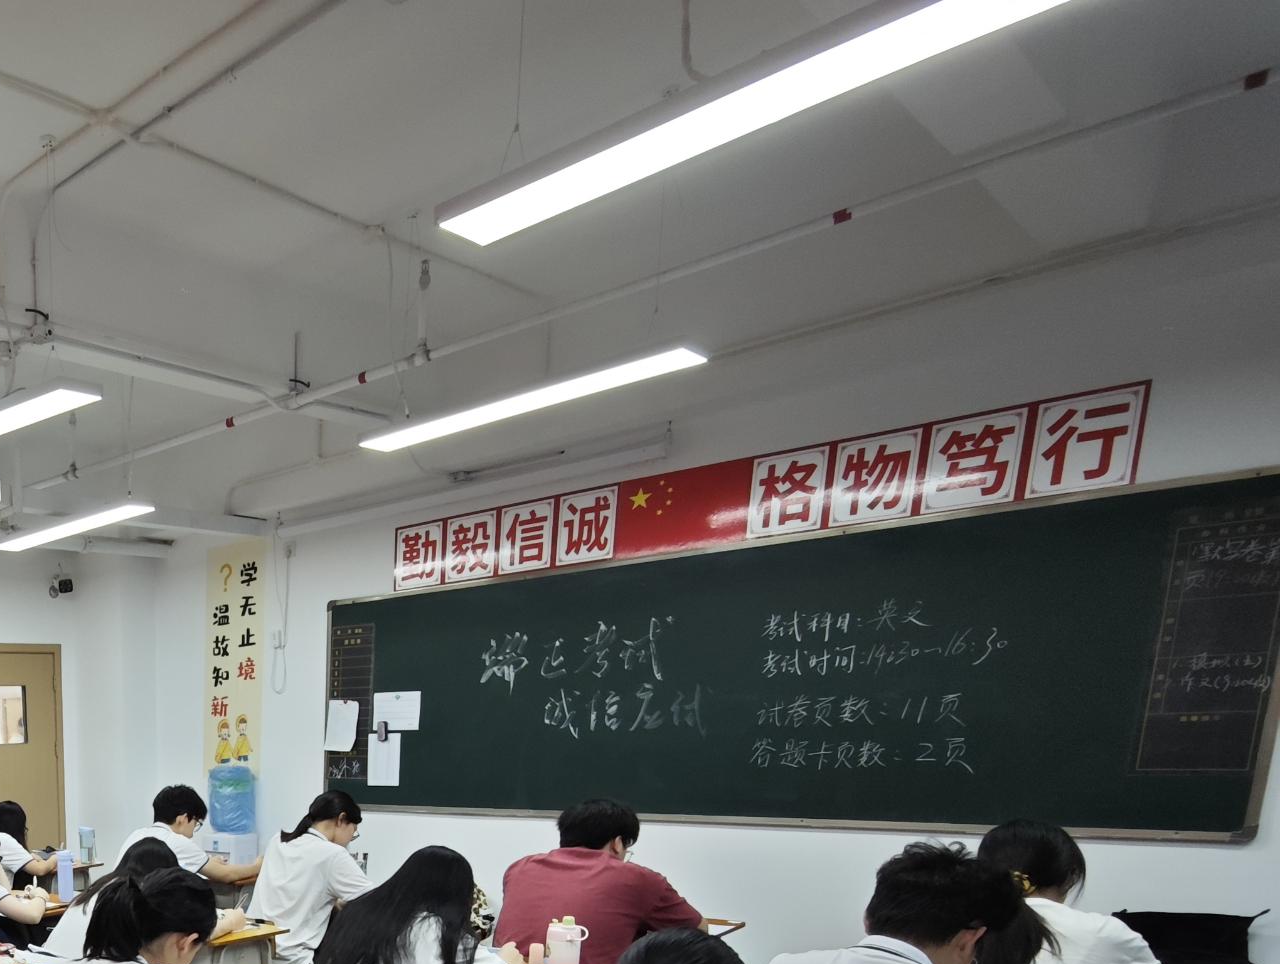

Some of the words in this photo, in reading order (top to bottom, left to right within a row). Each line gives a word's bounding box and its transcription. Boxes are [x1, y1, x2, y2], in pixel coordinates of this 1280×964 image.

[401, 496, 611, 582] 勤毅信诚
[759, 402, 1131, 529] 格物笃行
[211, 603, 231, 718] 温故知新
[237, 561, 258, 681] 学无止境
[749, 737, 975, 775] 答题卡页数：2页
[756, 693, 967, 728] 试卷页数：11页
